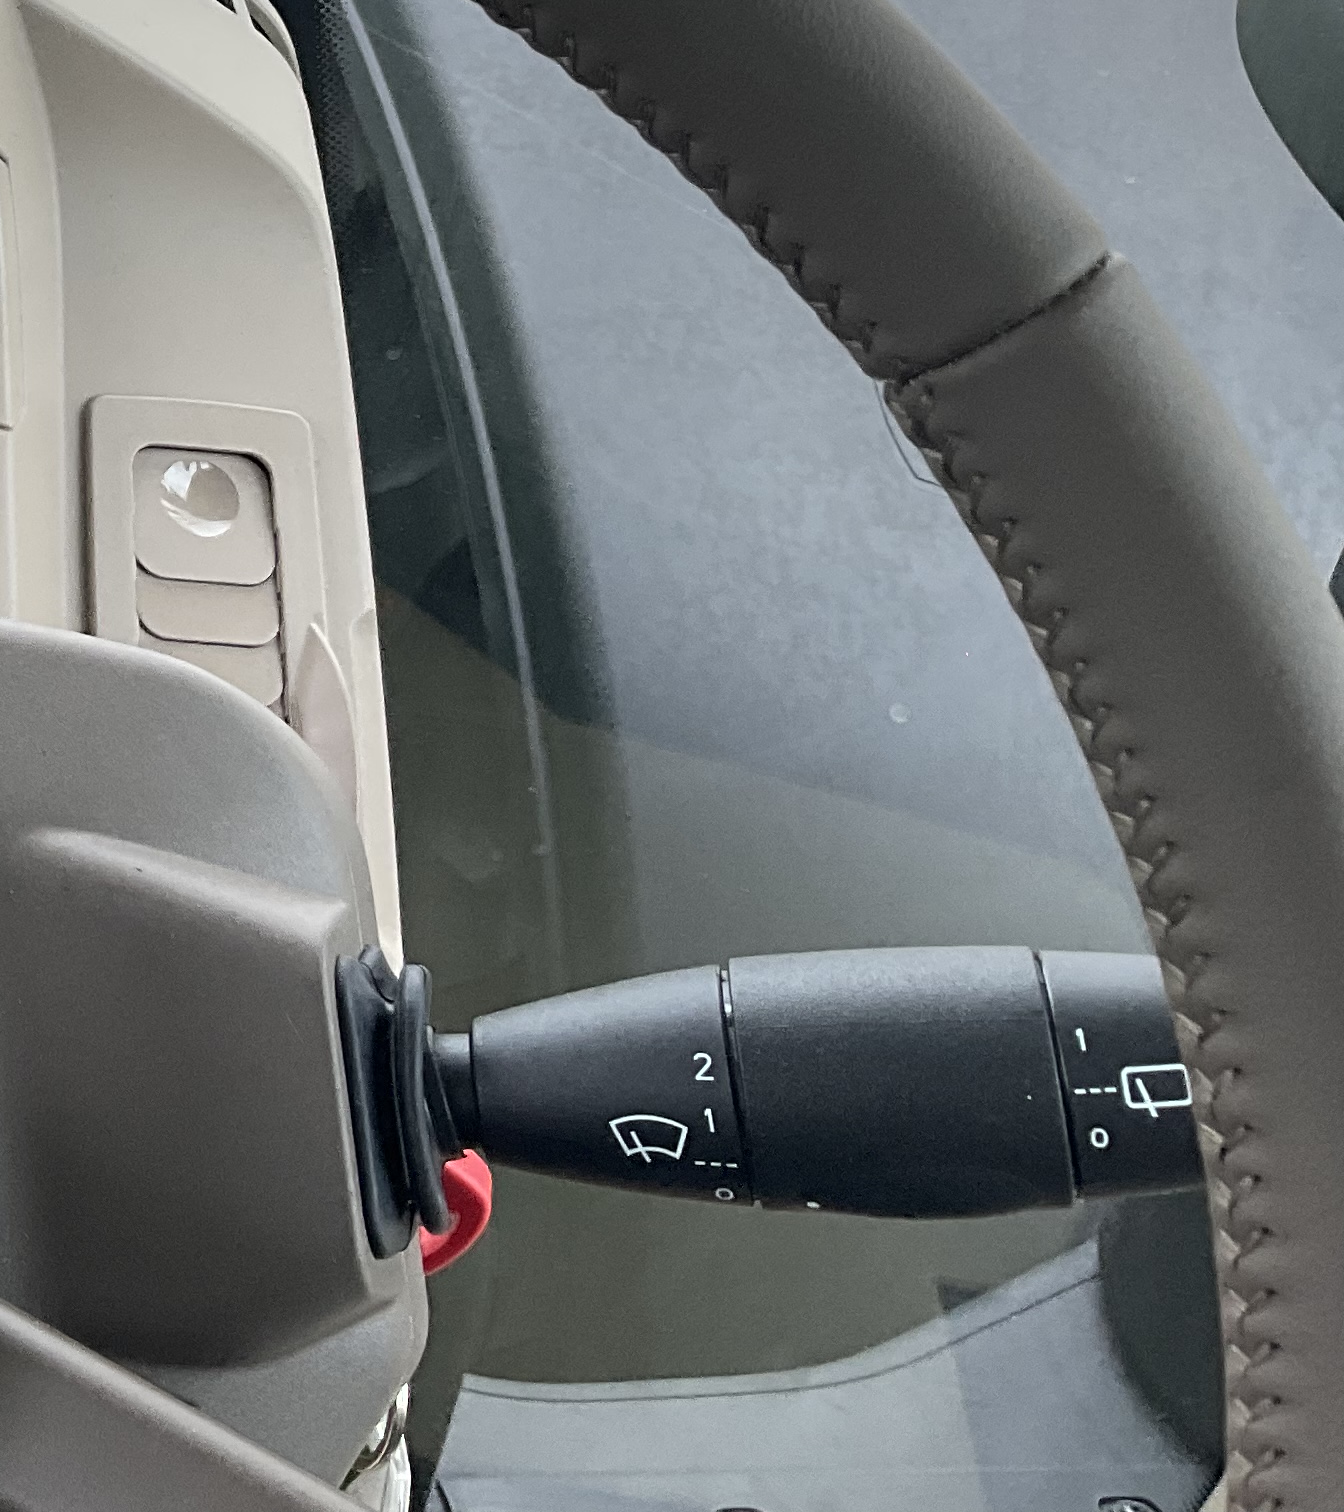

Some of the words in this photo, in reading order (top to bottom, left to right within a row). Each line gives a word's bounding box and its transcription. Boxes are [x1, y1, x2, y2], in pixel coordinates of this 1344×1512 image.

[1074, 1027, 1087, 1052] 1
[692, 1052, 715, 1082] 2
[703, 1107, 715, 1133] 1
